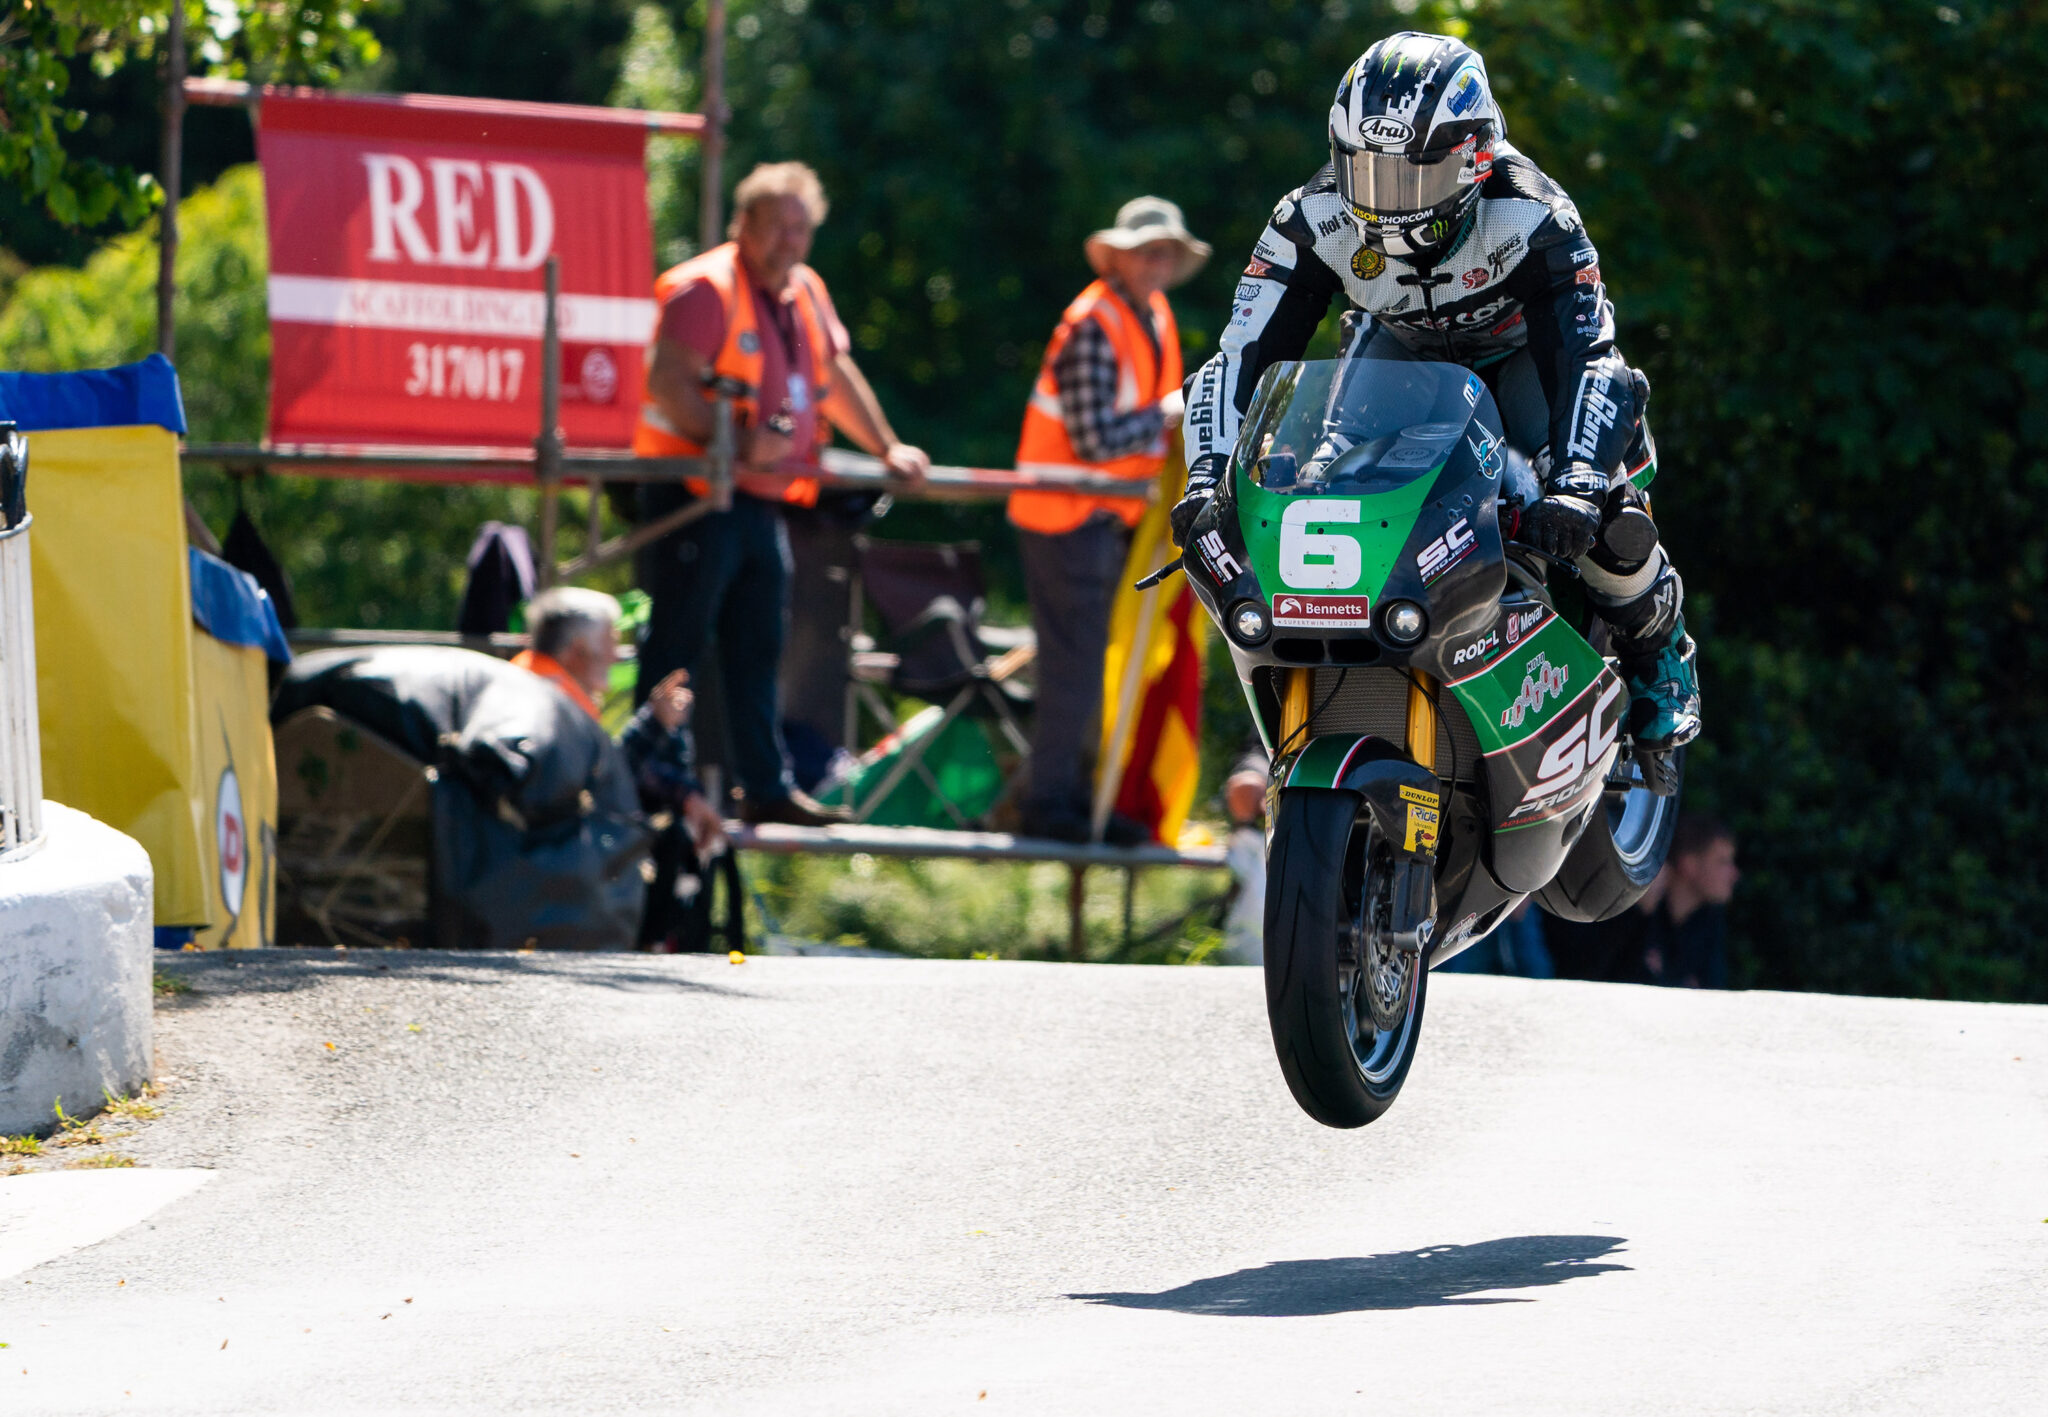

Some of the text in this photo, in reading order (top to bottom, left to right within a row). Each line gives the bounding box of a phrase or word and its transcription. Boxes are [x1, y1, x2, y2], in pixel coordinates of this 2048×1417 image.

[1361, 119, 1406, 138] Arai
[362, 153, 555, 271] RED
[405, 342, 525, 401] 317017
[1201, 529, 1243, 581] SC
[1278, 499, 1362, 589] 6
[1416, 517, 1474, 576] SC
[1305, 603, 1362, 615] Bennetts
[1521, 605, 1543, 633] Mevar
[1522, 676, 1622, 802] SC
[1405, 791, 1438, 804] DUNLOP
